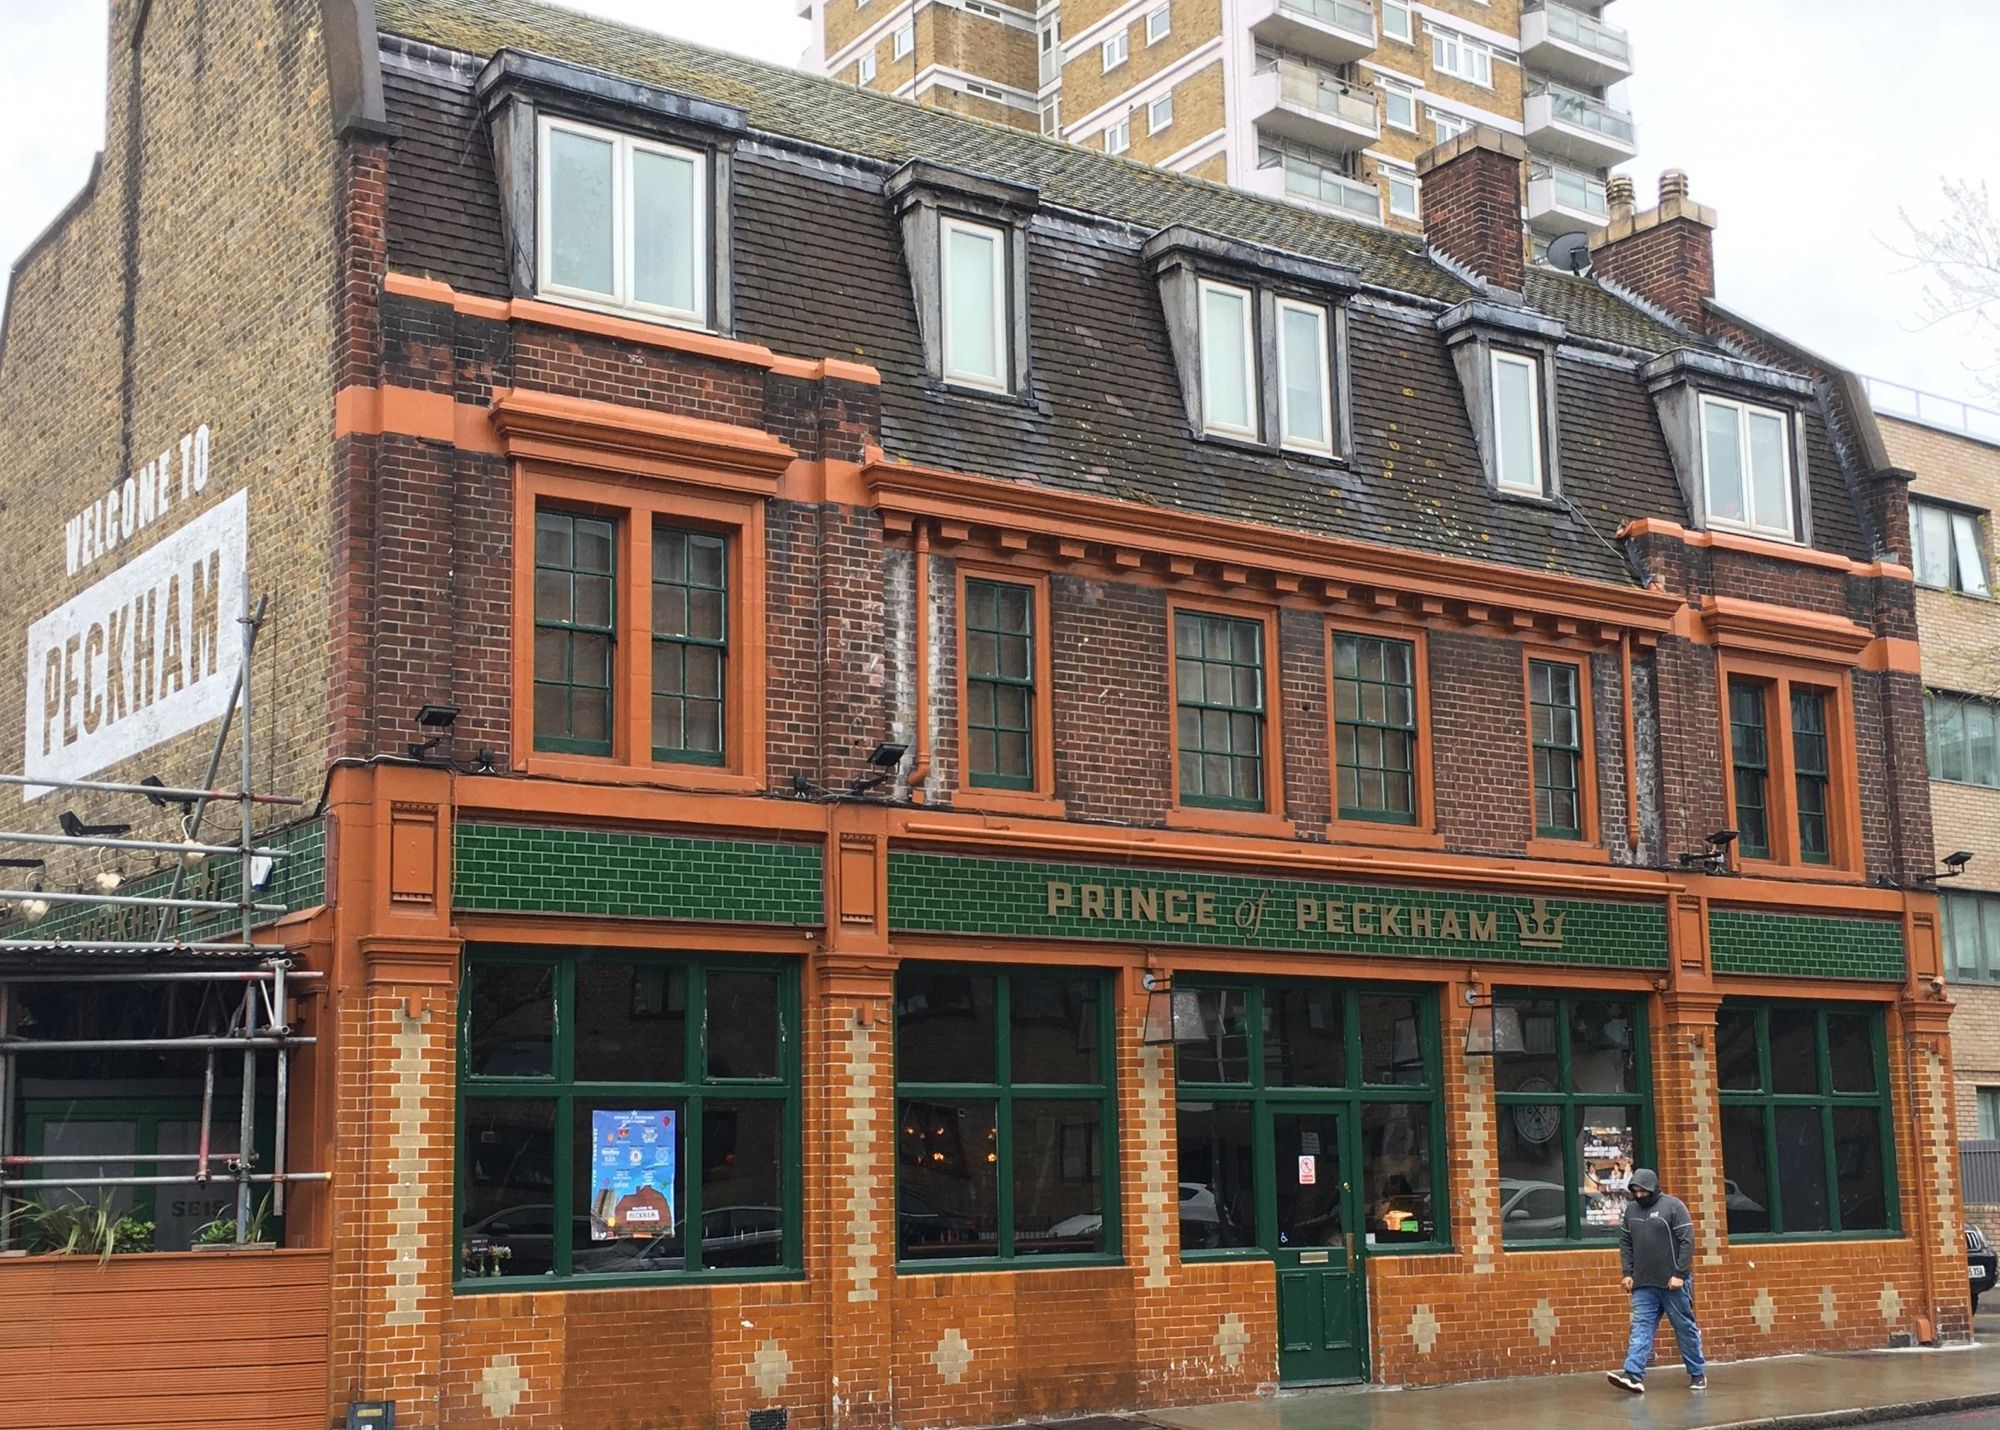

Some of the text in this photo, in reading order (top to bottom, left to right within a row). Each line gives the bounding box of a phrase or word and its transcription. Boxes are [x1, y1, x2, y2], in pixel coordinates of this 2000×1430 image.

[66, 423, 209, 577] WELCOME TO
[43, 548, 220, 757] PECKHAM
[1046, 881, 1498, 943] PRINCE of PECKHAM
